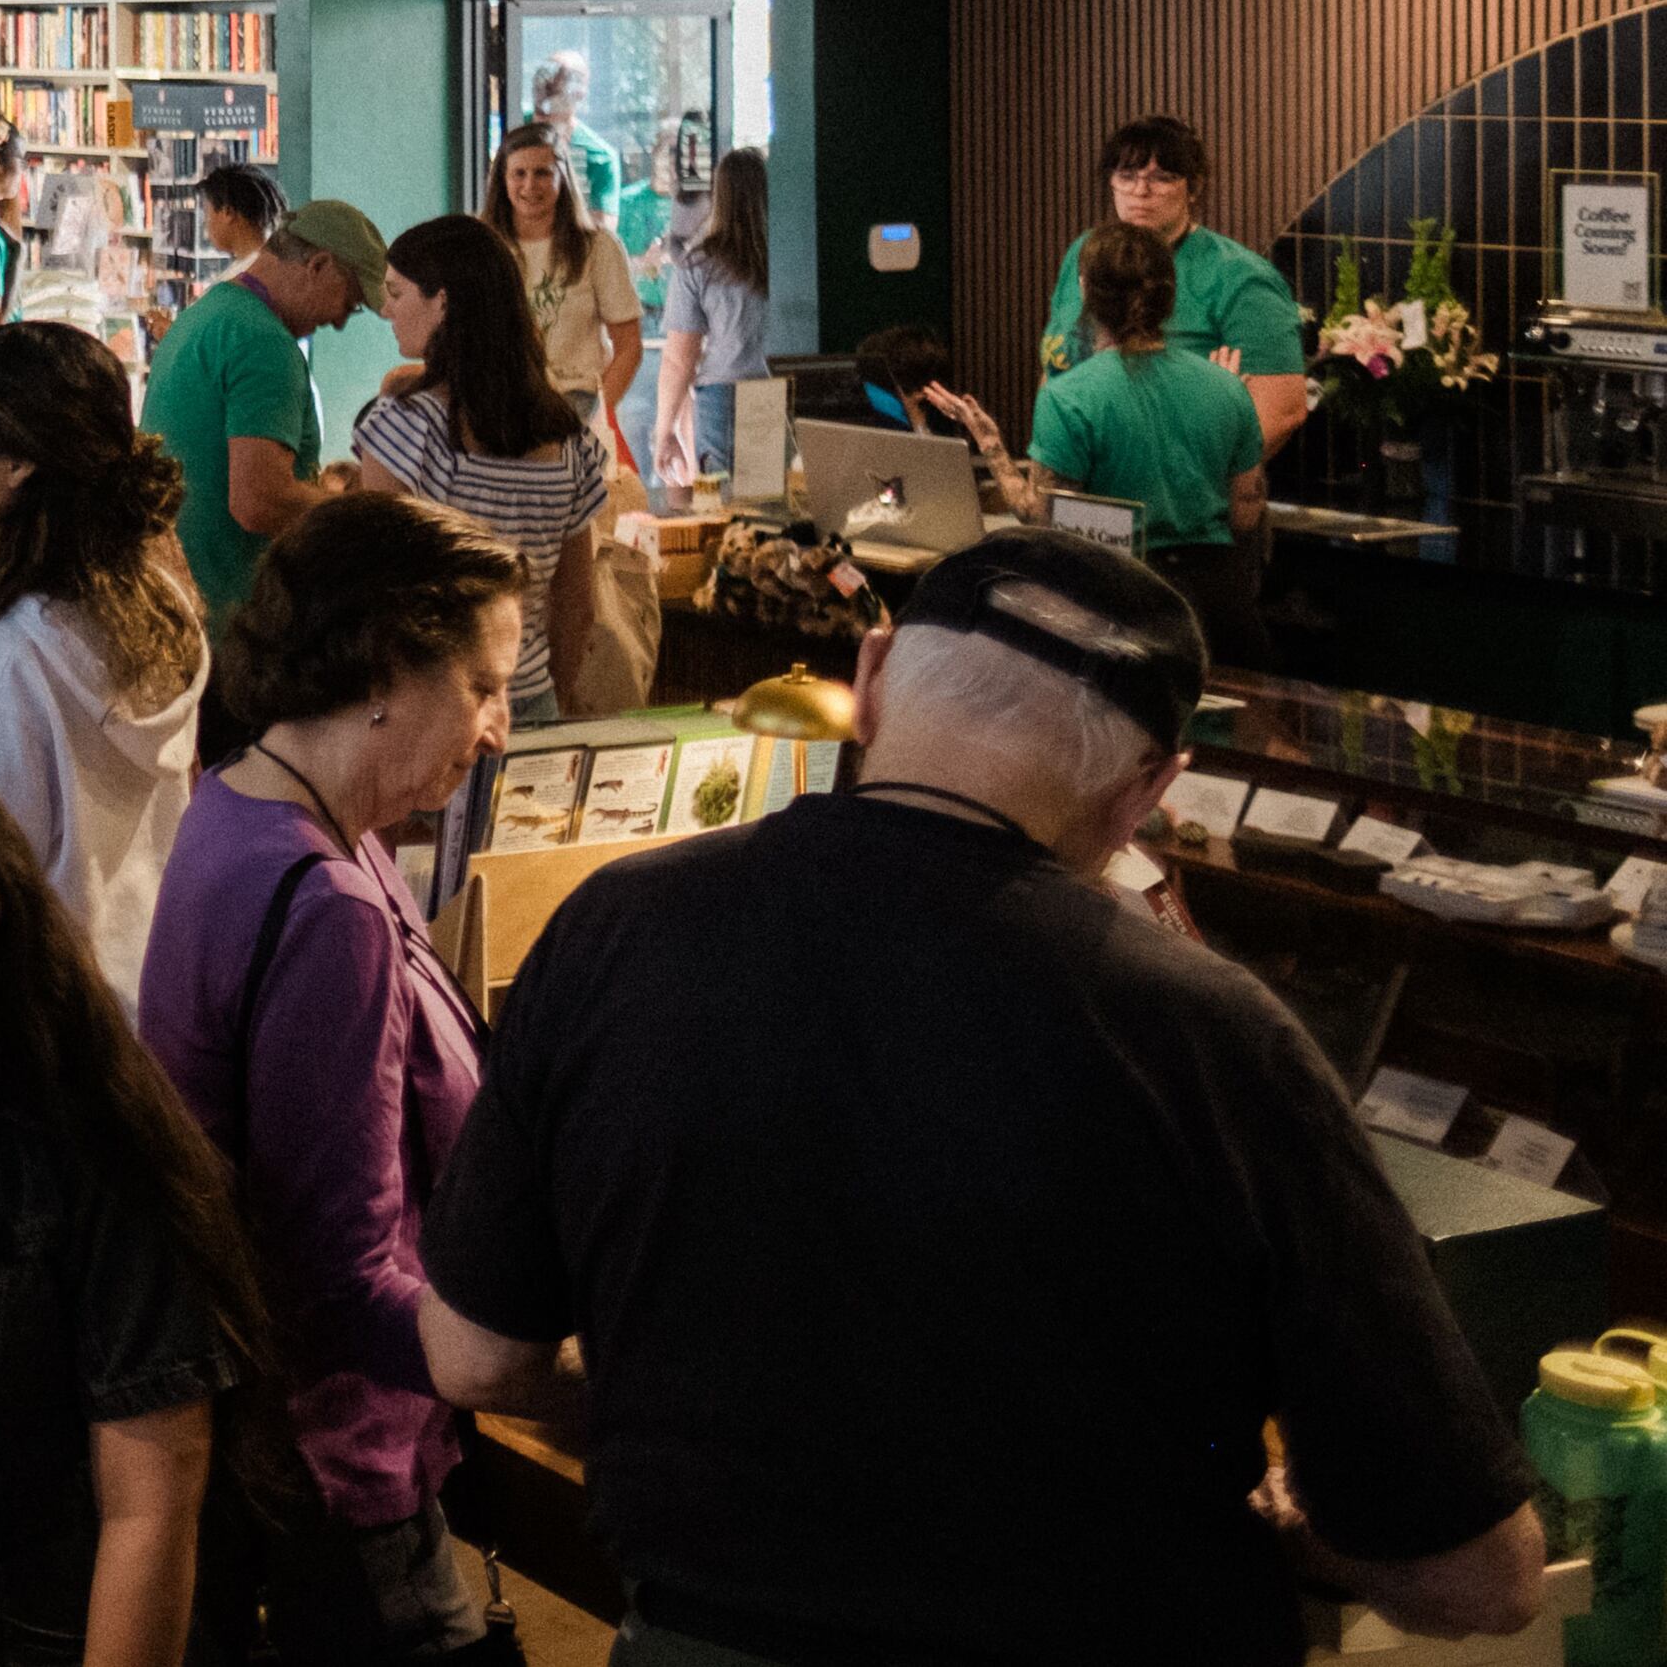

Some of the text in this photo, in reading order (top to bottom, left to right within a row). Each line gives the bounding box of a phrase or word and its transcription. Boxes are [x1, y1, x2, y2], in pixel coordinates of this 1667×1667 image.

[203, 105, 257, 117] PENGUIN
[203, 115, 257, 127] CLASSICS
[1577, 206, 1632, 223] Coffee
[1573, 222, 1637, 245] Coming
